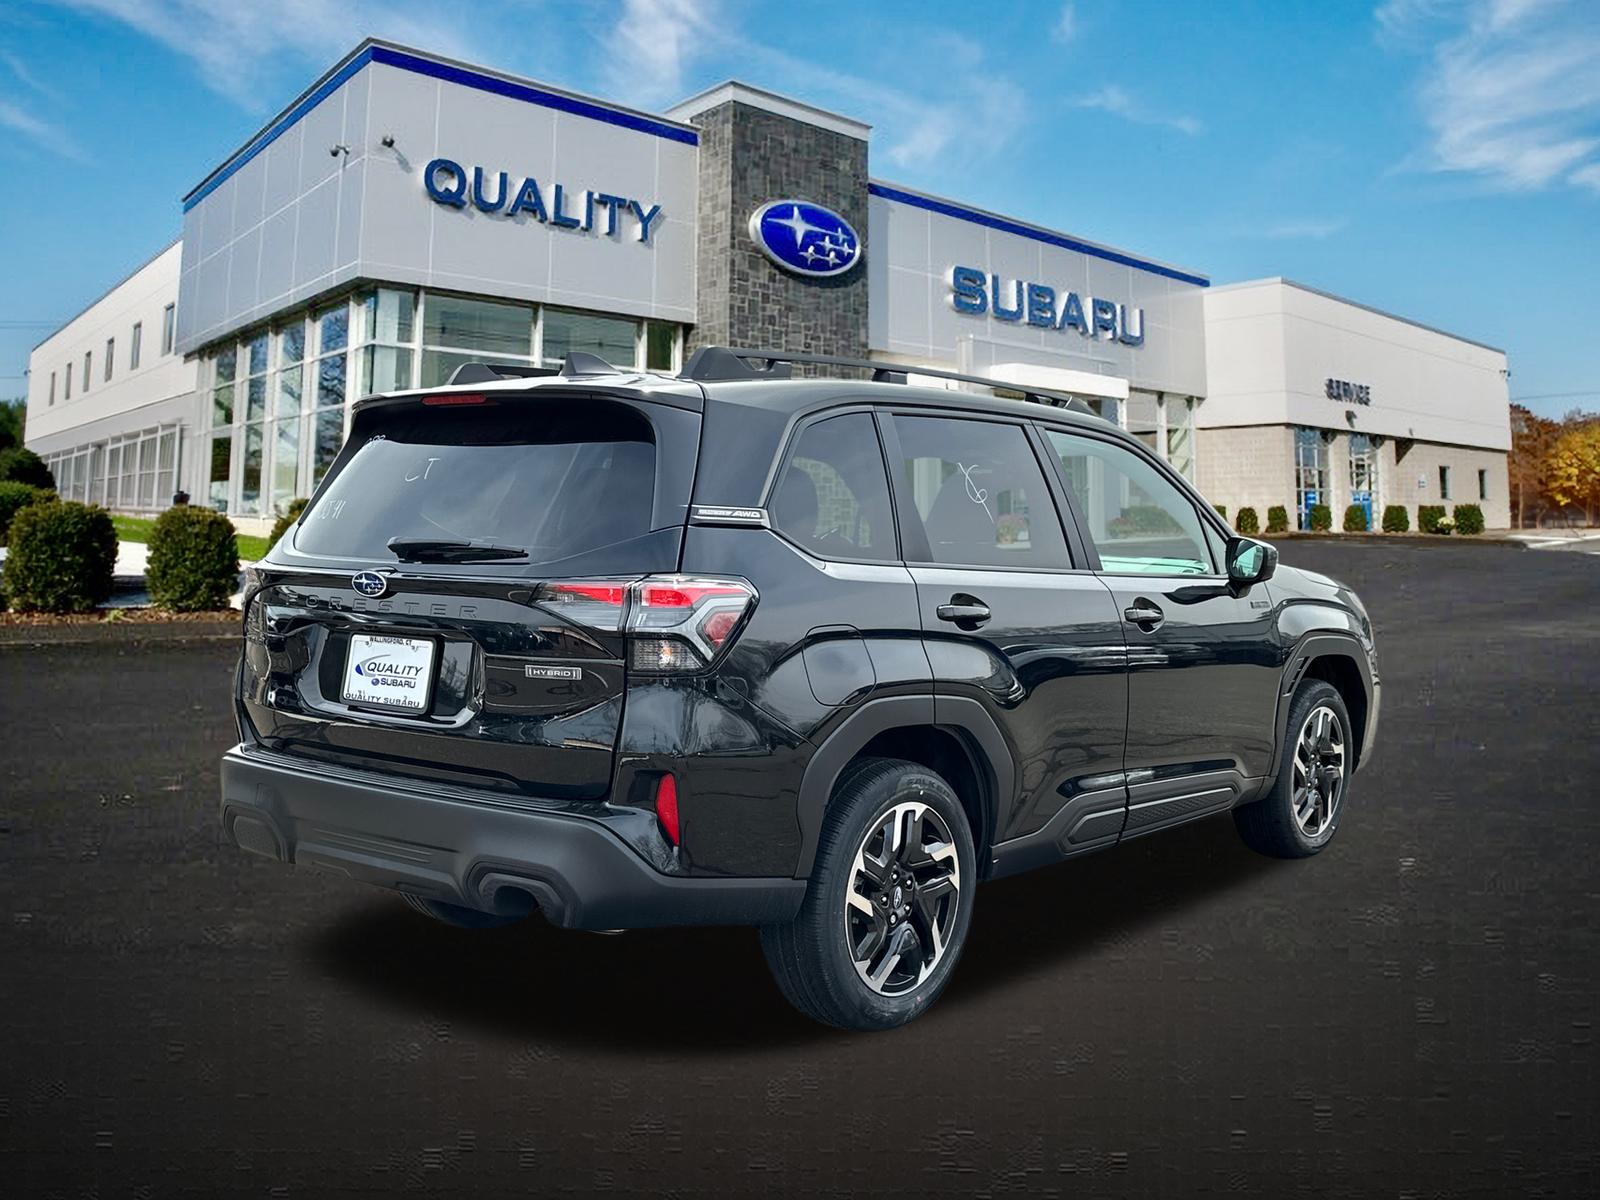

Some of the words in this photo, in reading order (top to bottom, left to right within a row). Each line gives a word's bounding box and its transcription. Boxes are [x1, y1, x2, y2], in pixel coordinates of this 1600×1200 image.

[423, 158, 663, 243] QUALITY
[950, 265, 1145, 347] SUBARU
[1325, 377, 1371, 407] SERVICE
[367, 661, 424, 676] QUALITY
[533, 668, 571, 677] HYBRID
[380, 677, 417, 689] SUBARU
[345, 692, 382, 702] QUALITY
[383, 697, 420, 708] SUBARU
